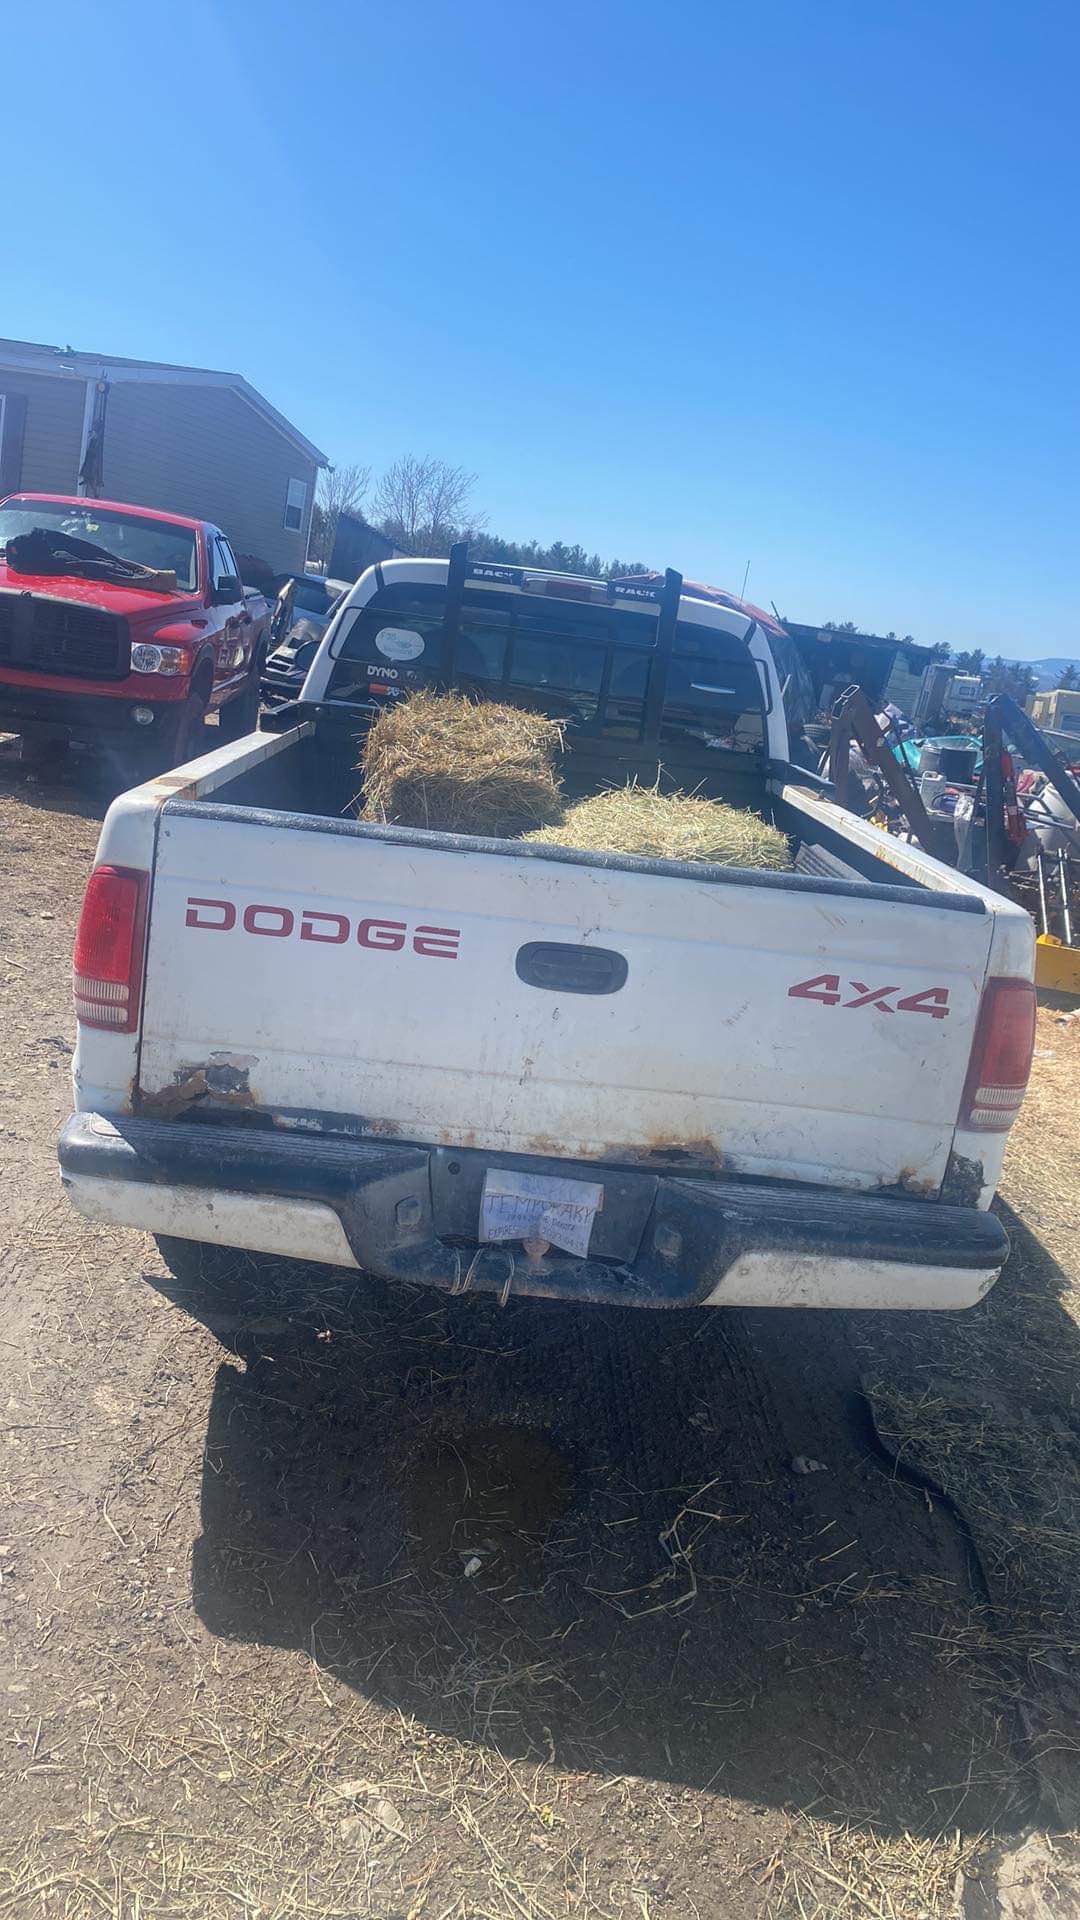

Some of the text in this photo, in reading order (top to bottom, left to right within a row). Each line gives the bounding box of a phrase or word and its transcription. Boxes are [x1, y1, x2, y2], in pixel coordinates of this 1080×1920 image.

[615, 586, 656, 598] RACK
[367, 665, 398, 679] DYNO
[185, 897, 460, 959] DODGE
